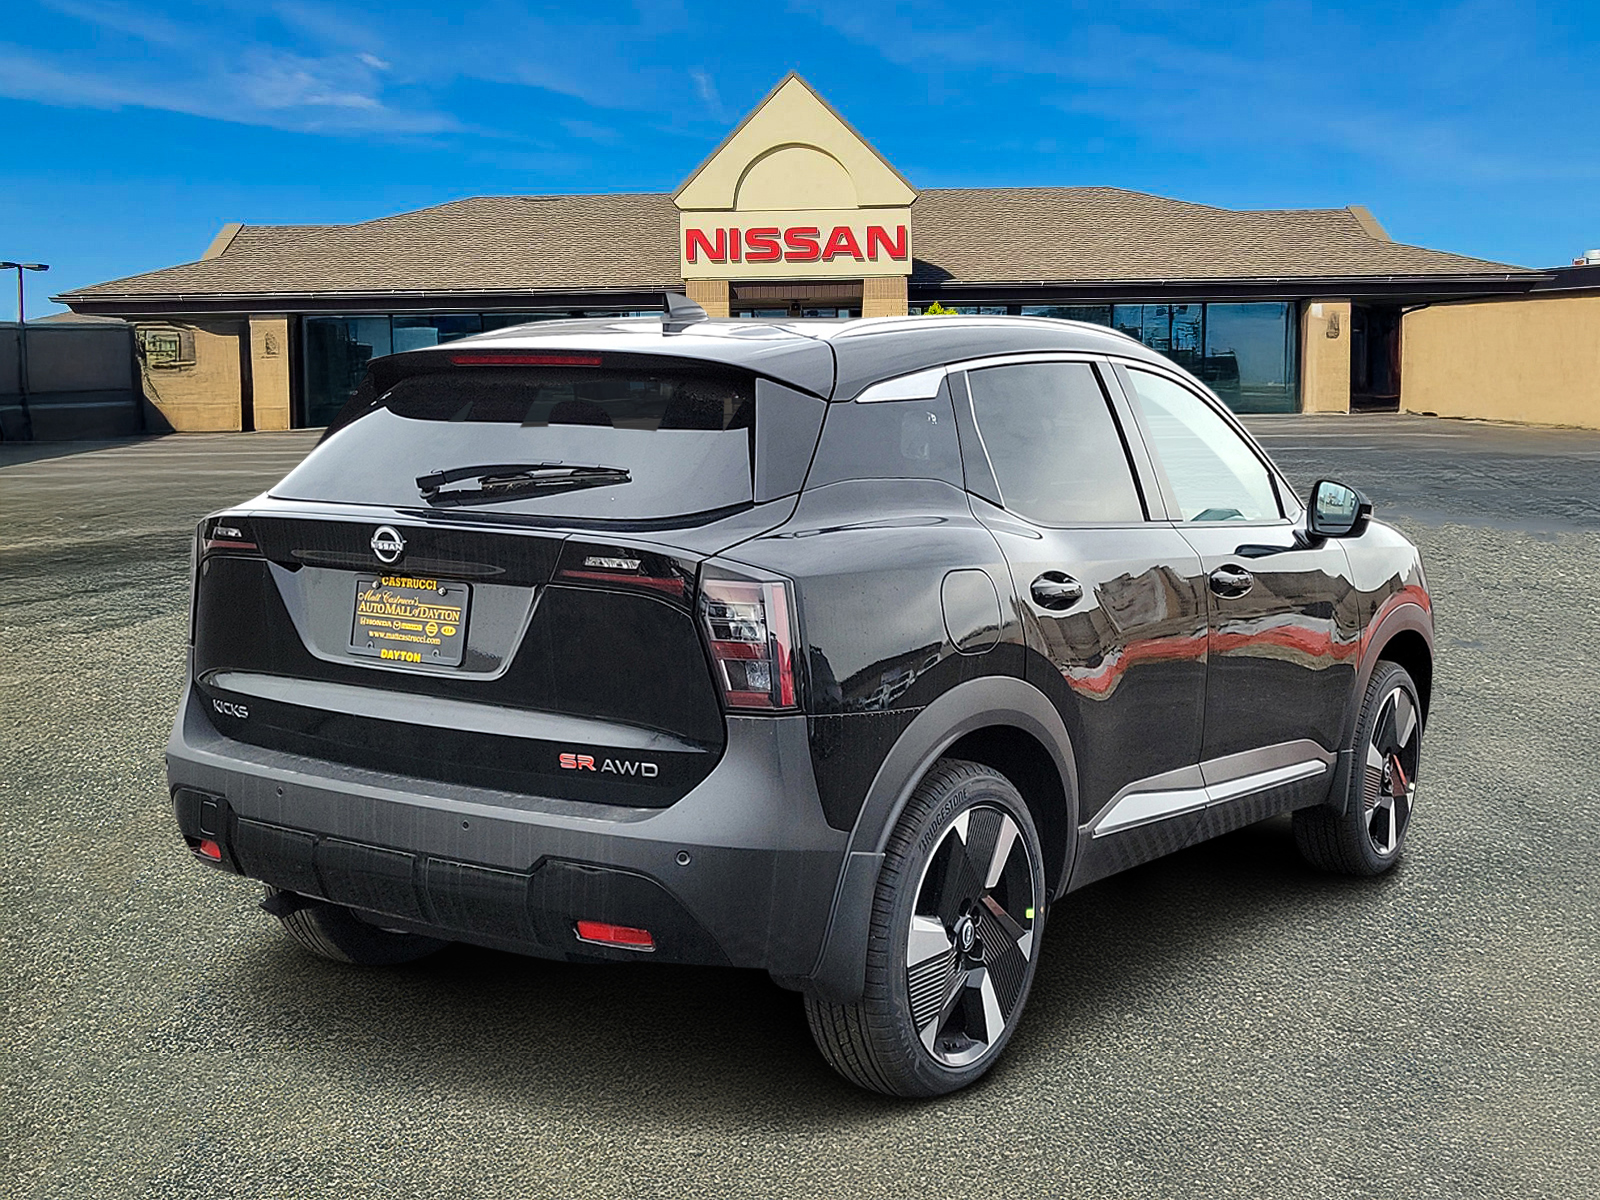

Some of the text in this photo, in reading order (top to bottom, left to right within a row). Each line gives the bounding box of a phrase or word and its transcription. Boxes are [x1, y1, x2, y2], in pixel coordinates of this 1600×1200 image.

[685, 225, 908, 264] NISSAN
[371, 538, 403, 551] NISSAN
[381, 576, 437, 591] CASTRUCCI
[420, 607, 460, 621] DAYTON
[380, 648, 421, 663] DAYTON
[212, 699, 249, 719] KICKS
[559, 753, 659, 777] SR AWD
[918, 787, 968, 854] BRIDGESTONE
